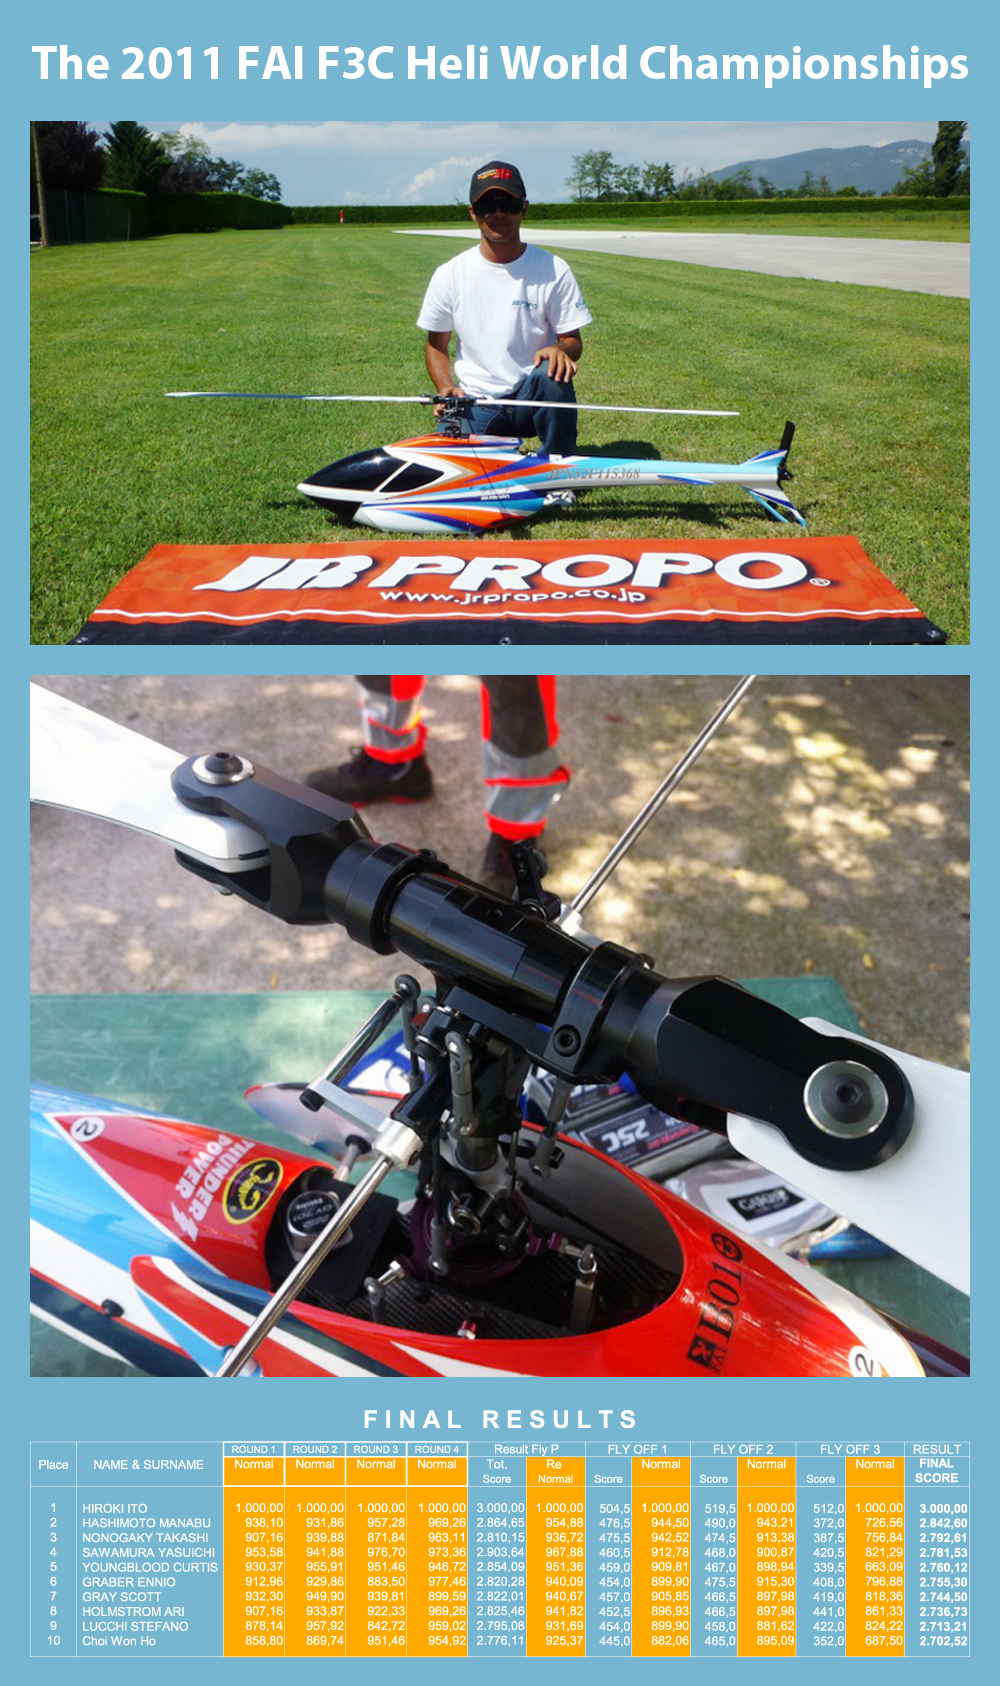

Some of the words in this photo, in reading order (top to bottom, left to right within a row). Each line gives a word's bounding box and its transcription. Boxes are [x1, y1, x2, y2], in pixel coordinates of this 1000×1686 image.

[193, 555, 373, 592] JR
[367, 552, 808, 592] PROPO
[379, 587, 647, 605] www.jrpropo.co.jp
[175, 1134, 234, 1199] POWER
[189, 1138, 256, 1221] THUNDER
